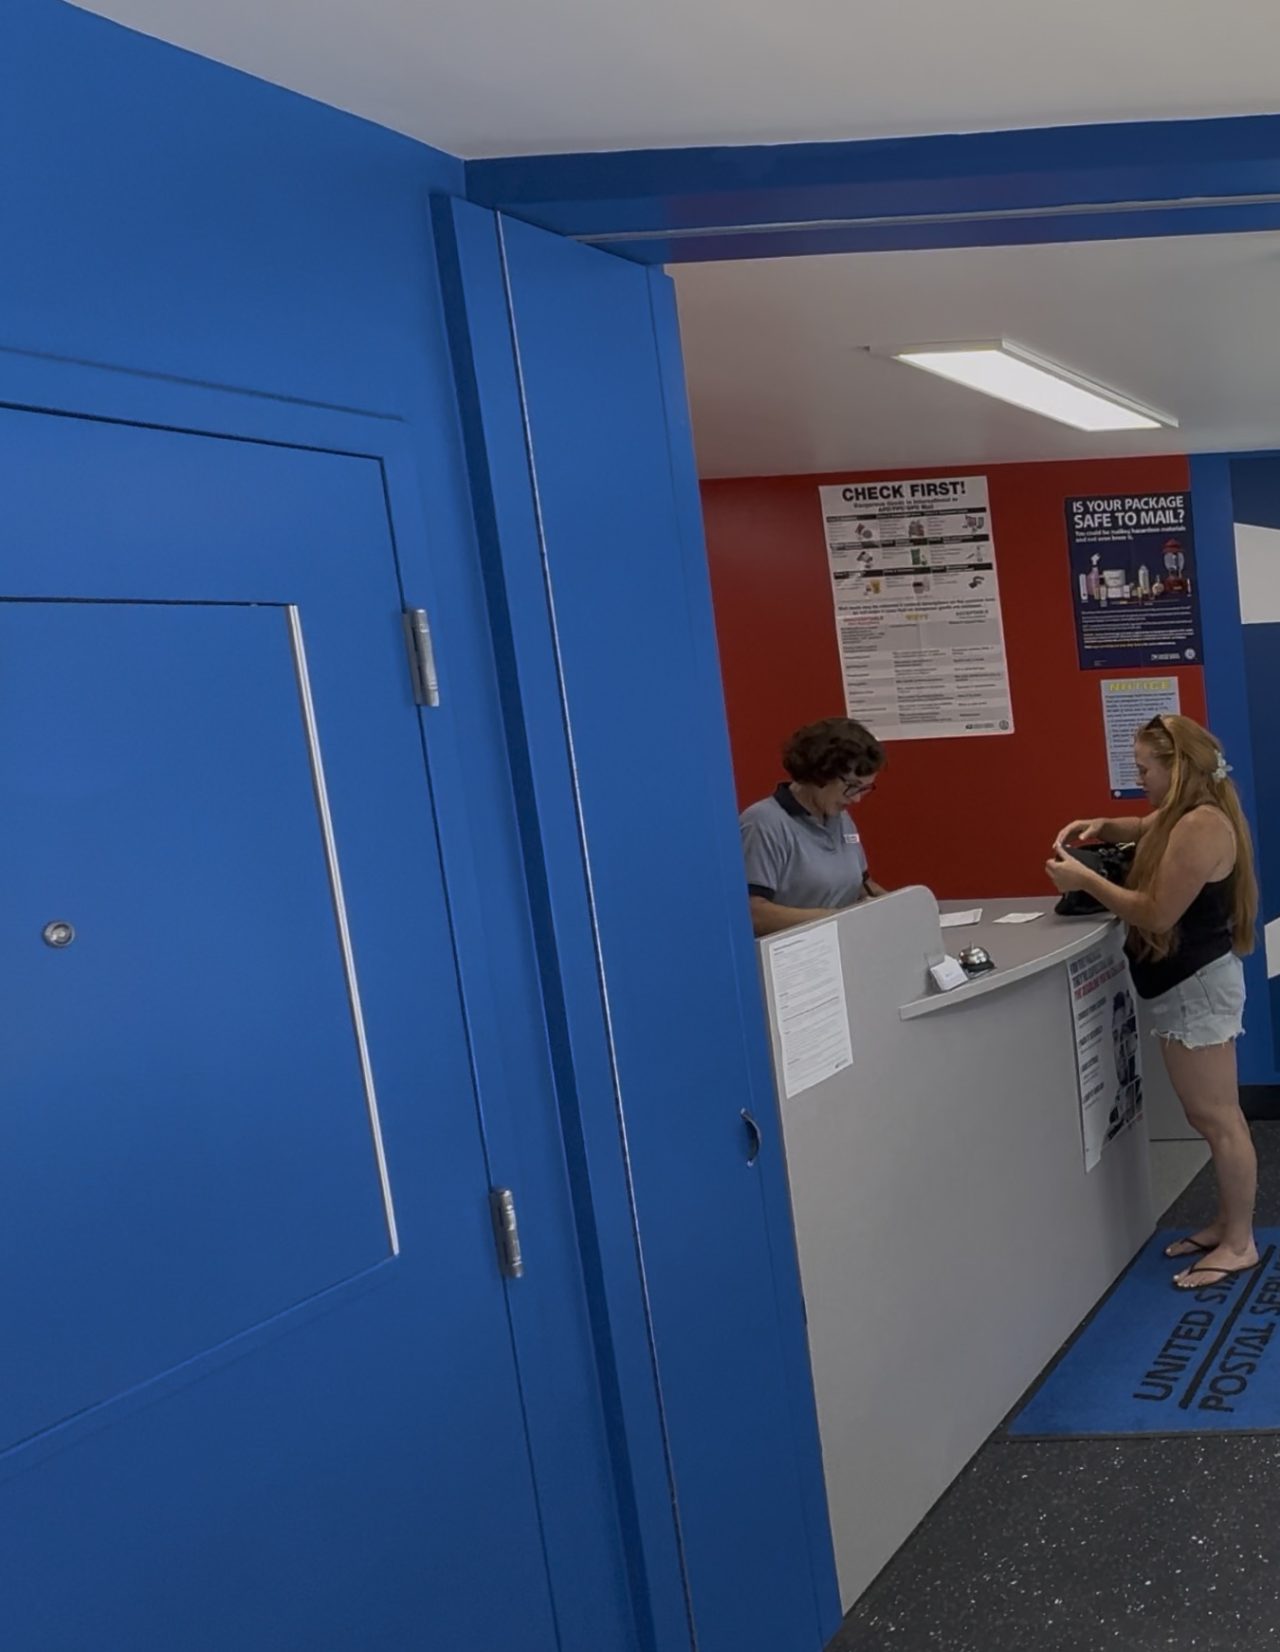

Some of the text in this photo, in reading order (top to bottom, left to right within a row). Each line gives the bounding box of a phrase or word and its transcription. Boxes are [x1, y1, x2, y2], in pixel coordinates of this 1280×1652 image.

[842, 481, 966, 502] CHECK FIRST!
[1072, 496, 1184, 513] IS YOUR PACKAGE
[1074, 509, 1185, 529] SAFE TO MAIL?
[1132, 1309, 1216, 1402] UNITED
[1197, 1322, 1277, 1413] POSTAL
